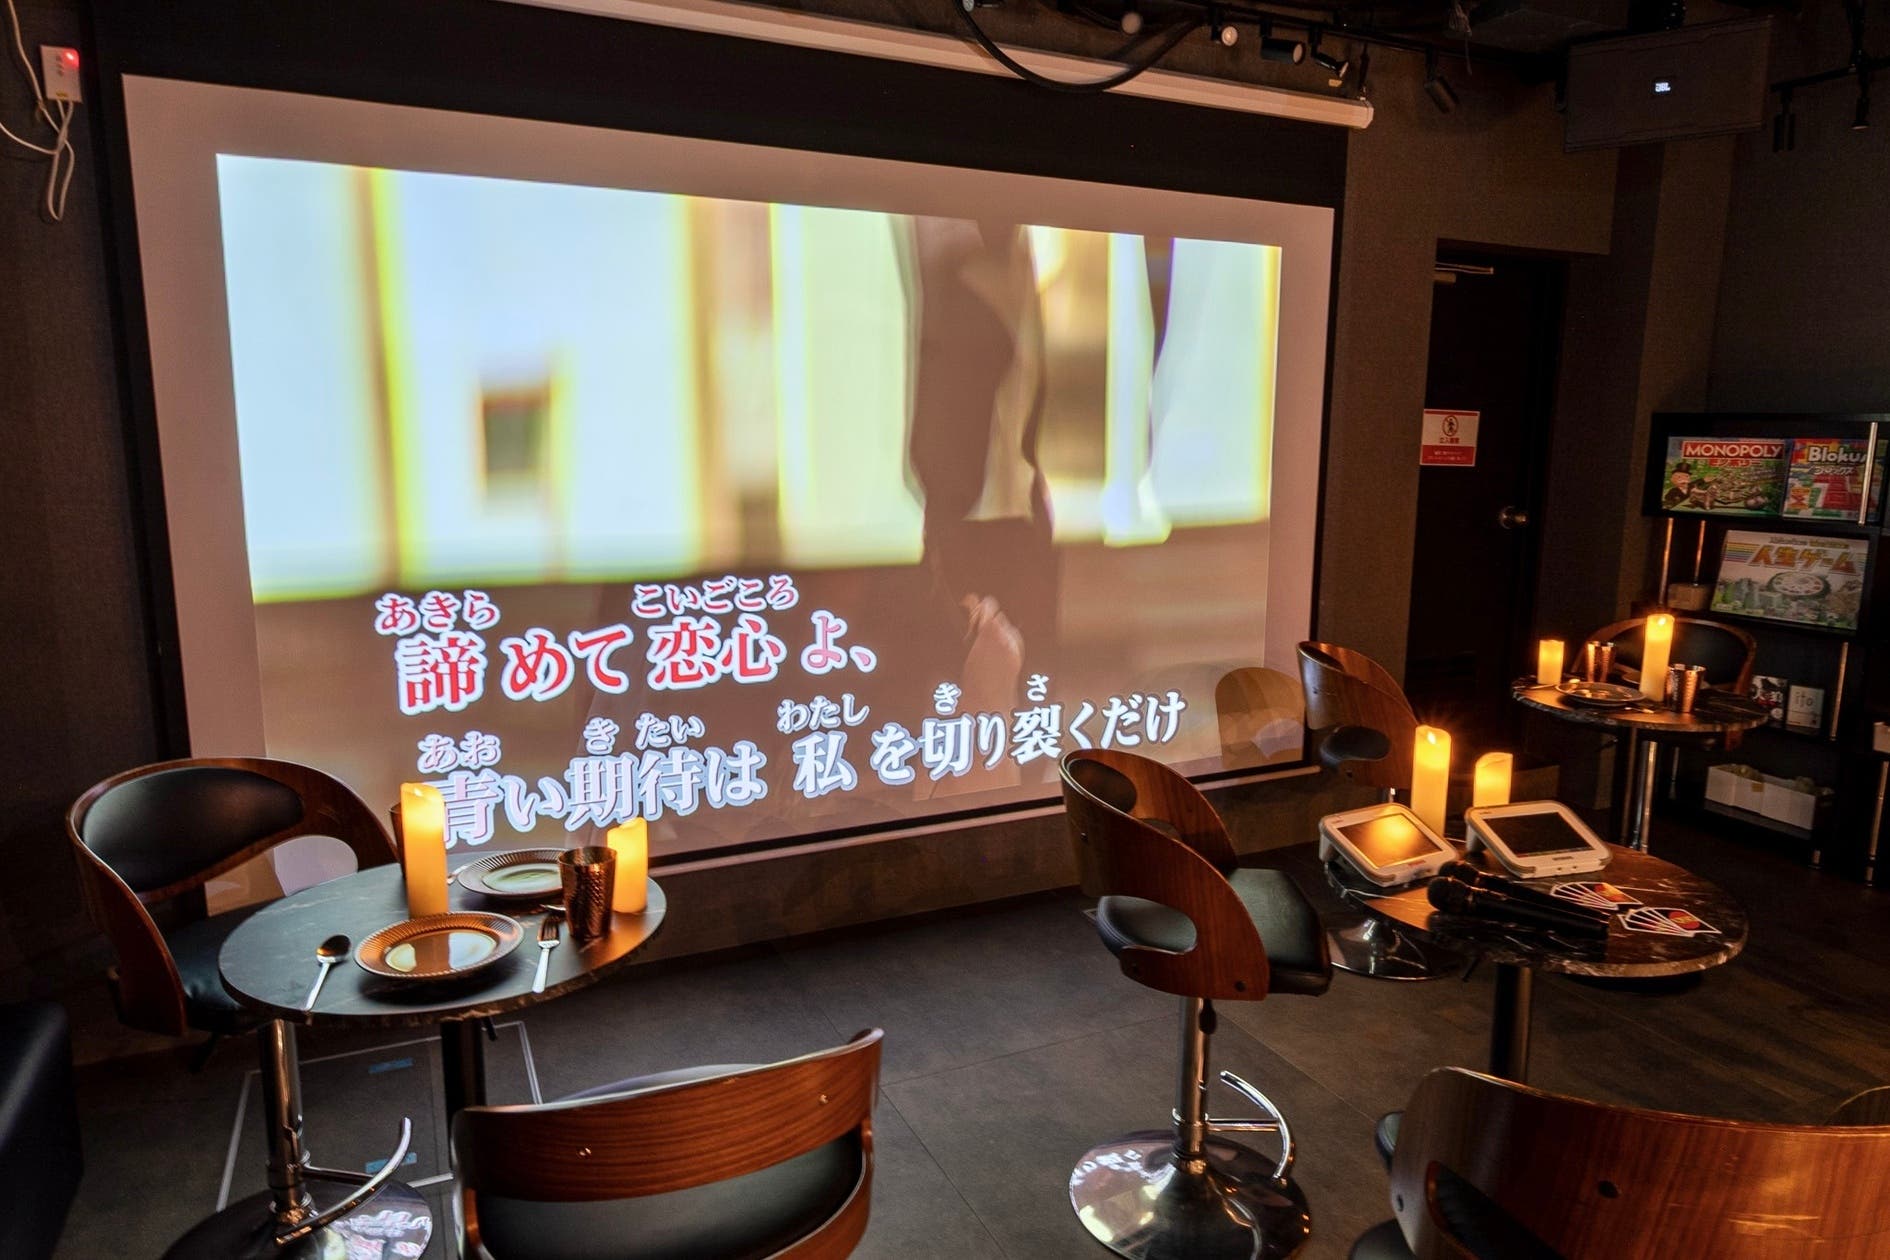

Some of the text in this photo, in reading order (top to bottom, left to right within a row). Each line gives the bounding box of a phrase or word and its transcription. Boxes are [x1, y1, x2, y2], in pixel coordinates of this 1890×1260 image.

[1685, 443, 1782, 458] MONOPOLY
[375, 575, 799, 635] あきら こいごころ
[417, 730, 501, 774] あお
[776, 693, 870, 735] わたし
[933, 682, 961, 715] き
[1026, 673, 1050, 702] さ
